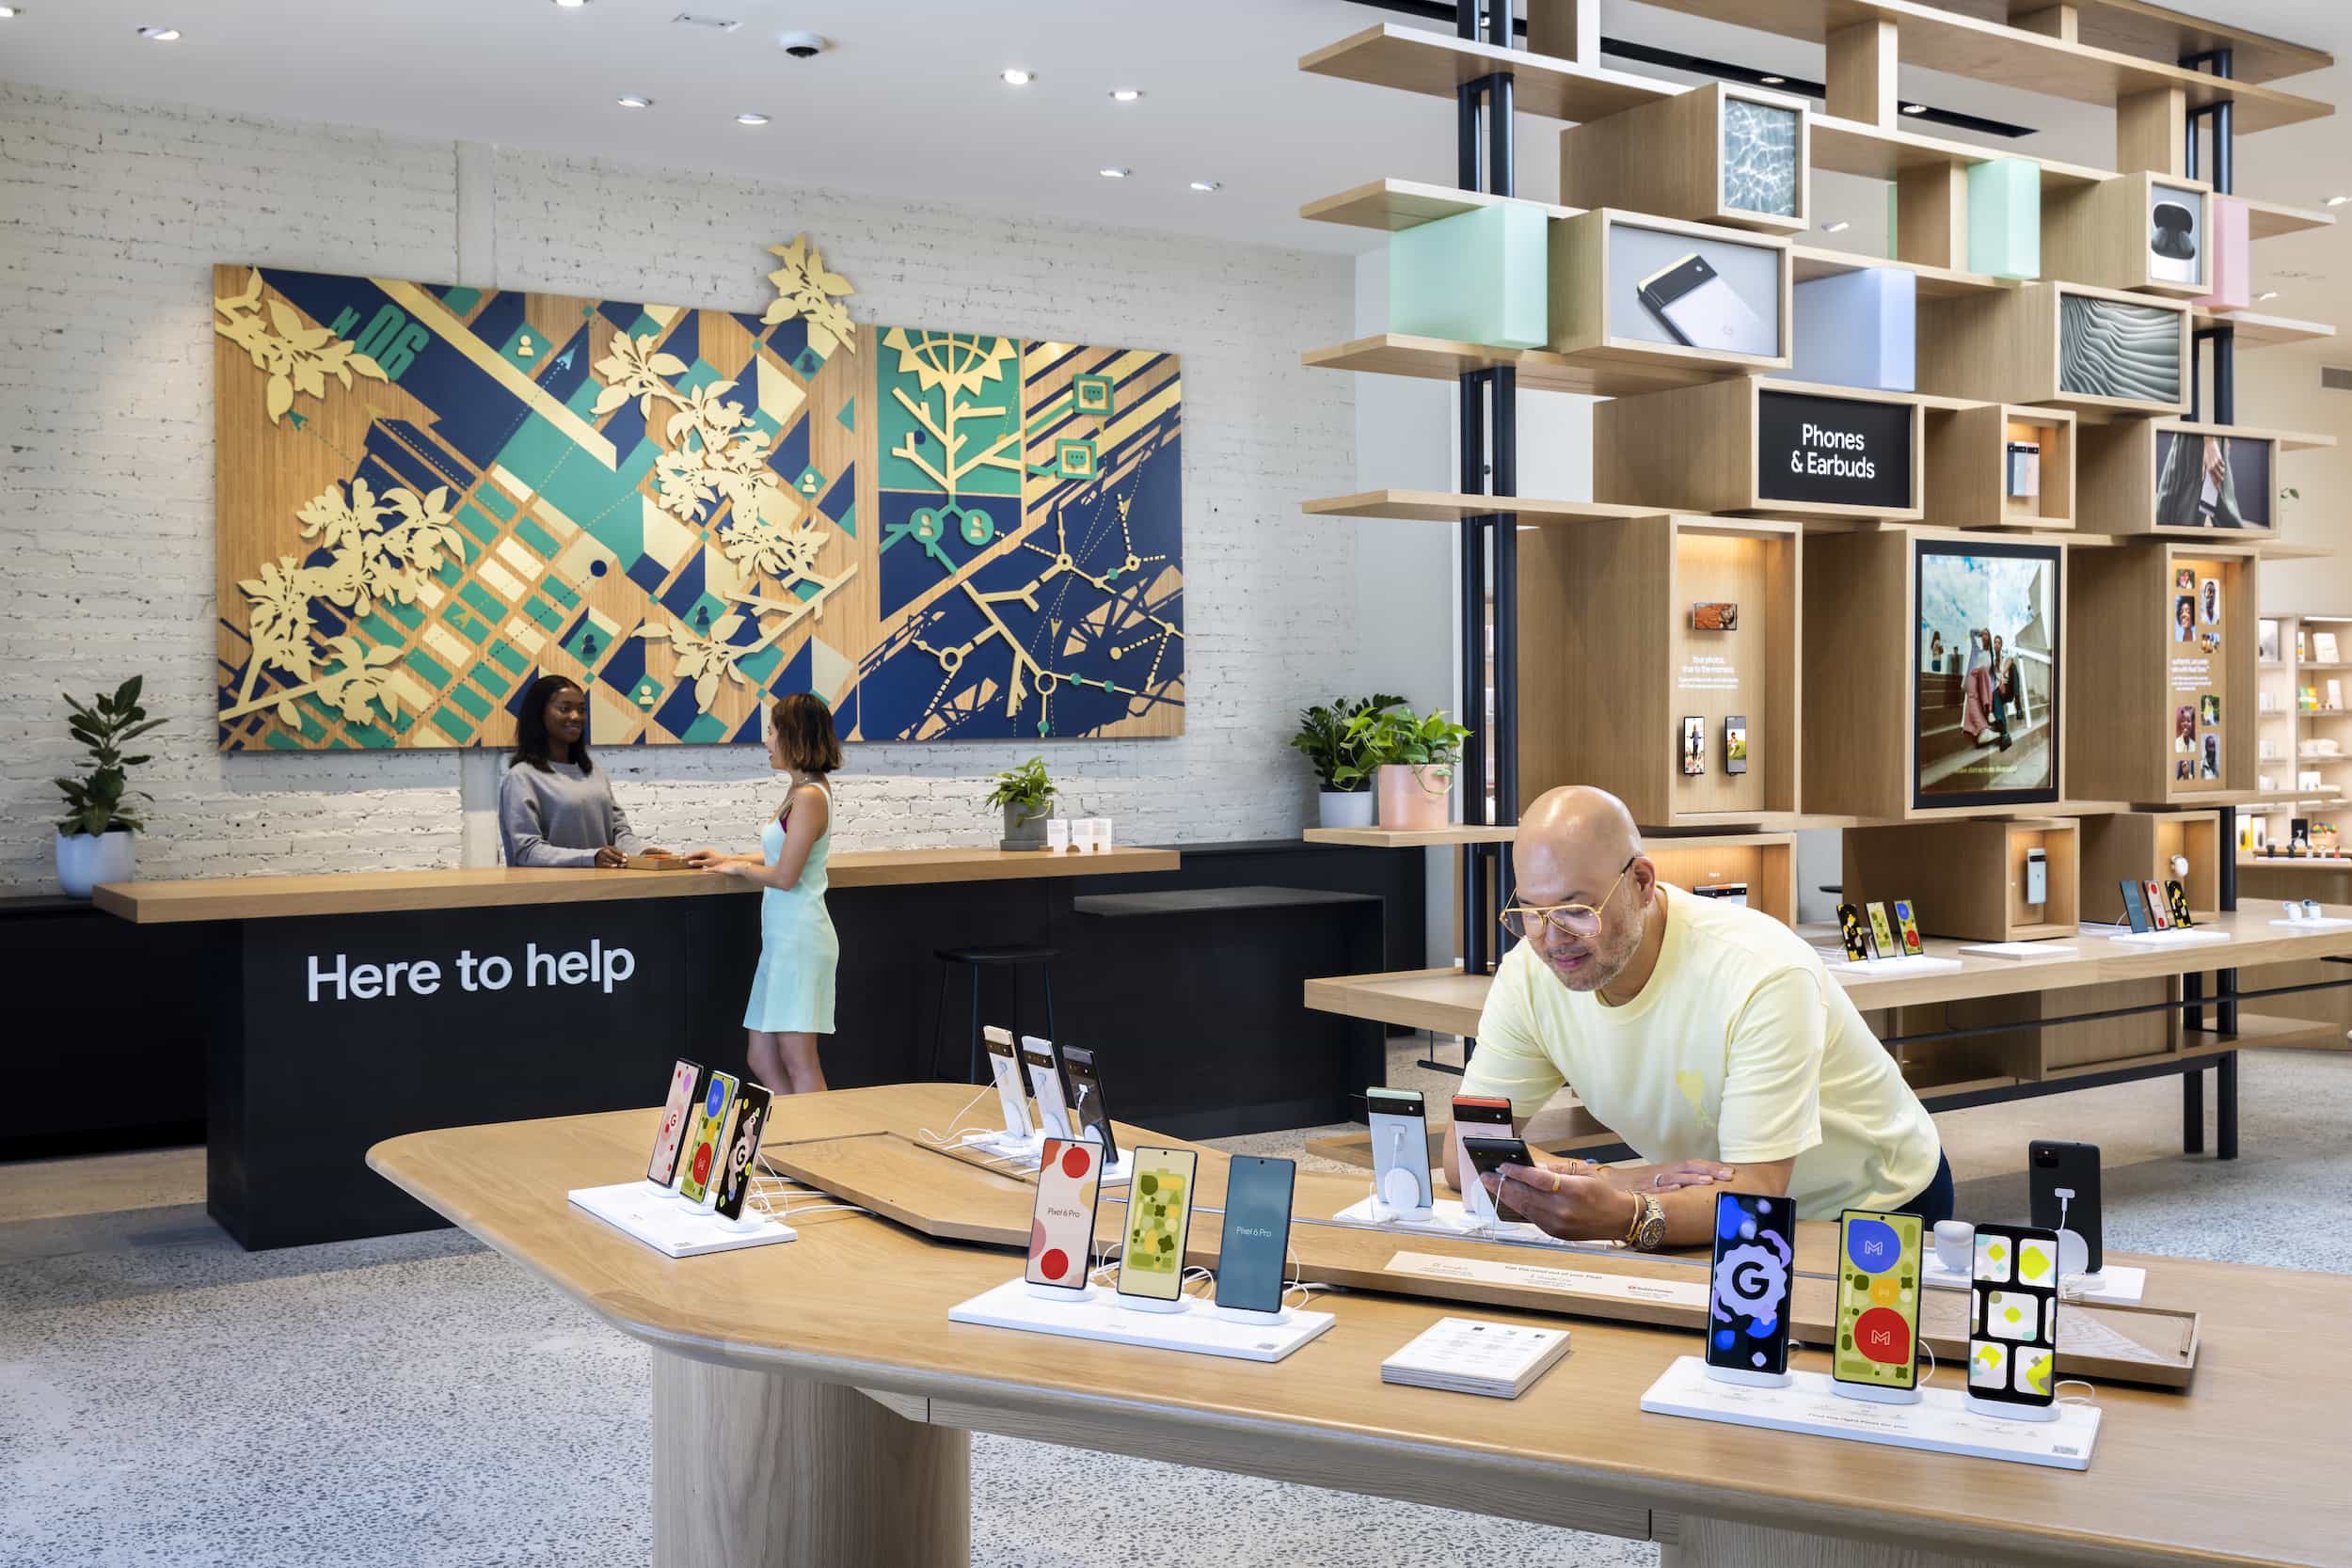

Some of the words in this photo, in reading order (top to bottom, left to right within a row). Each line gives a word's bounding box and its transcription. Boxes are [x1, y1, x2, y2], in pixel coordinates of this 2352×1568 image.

[354, 304, 430, 382] 06
[1802, 423, 1865, 451] Phones
[1790, 450, 1804, 473] &
[1807, 451, 1876, 479] Earbuds
[308, 954, 441, 1002] Here
[455, 950, 513, 991] to
[526, 939, 635, 994] help
[736, 1144, 746, 1166] G
[1047, 1207, 1063, 1216] Pixel
[1069, 1209, 1081, 1218] Pro
[1235, 1226, 1252, 1235] Pixel
[1260, 1227, 1272, 1238] Pro
[1731, 1261, 1770, 1300] G
